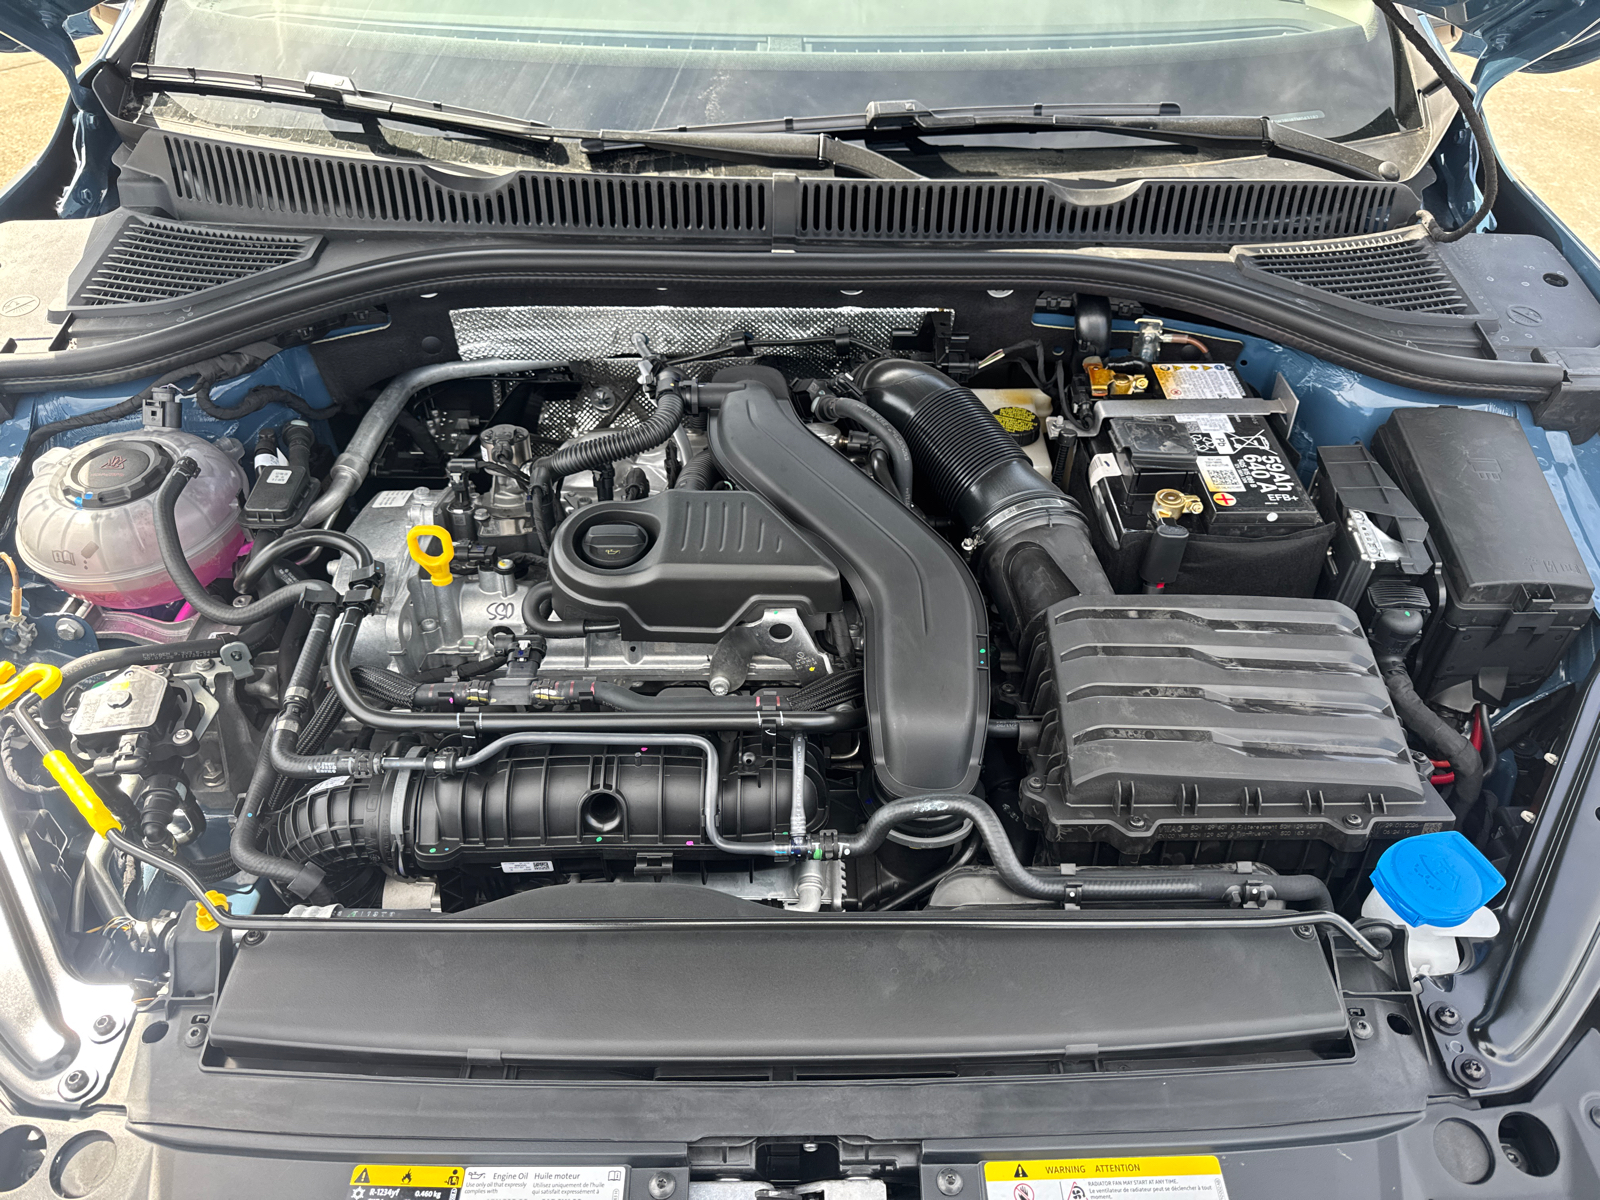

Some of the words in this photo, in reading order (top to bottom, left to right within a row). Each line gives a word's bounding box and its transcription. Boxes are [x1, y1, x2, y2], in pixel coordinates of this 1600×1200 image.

[1215, 437, 1227, 447] Pb
[1243, 454, 1271, 479] 640
[1261, 455, 1295, 492] 59Ah
[1256, 481, 1278, 493] A
[1266, 493, 1299, 502] EFB+
[1045, 1165, 1086, 1174] WARNING
[1095, 1163, 1141, 1173] ATTENTION
[492, 1172, 517, 1182] Engine
[518, 1172, 529, 1180] Oil
[534, 1172, 553, 1180] Huile
[554, 1172, 580, 1180] moteur
[504, 1181, 527, 1189] expressly
[368, 1187, 401, 1198] R-1234yf
[414, 1190, 433, 1198] 0.460
[433, 1190, 442, 1199] kg
